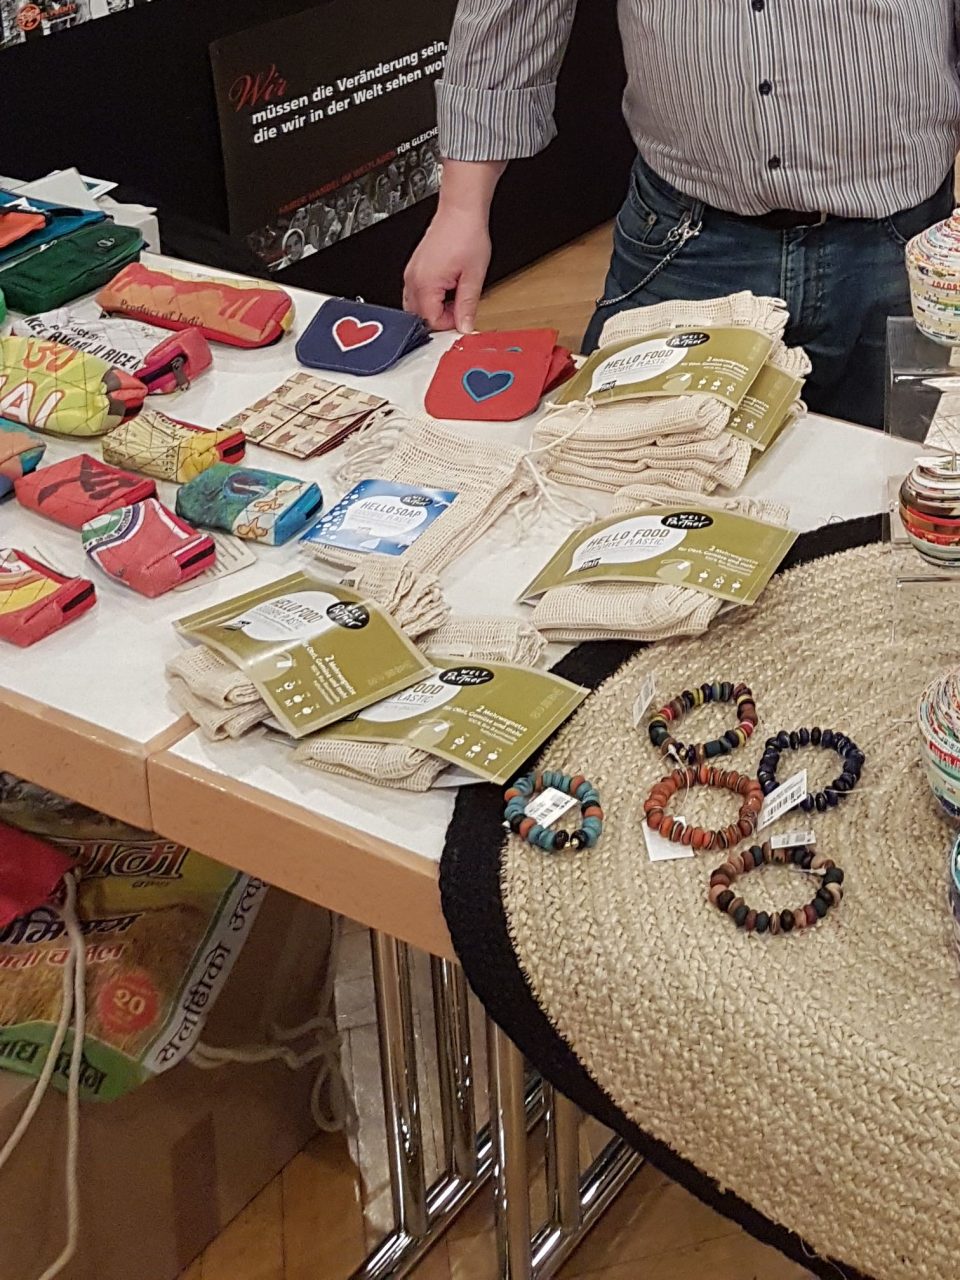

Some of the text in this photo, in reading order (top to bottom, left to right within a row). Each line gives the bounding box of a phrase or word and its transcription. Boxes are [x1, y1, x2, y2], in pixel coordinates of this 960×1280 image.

[228, 64, 288, 113] Wir
[252, 39, 448, 124] müssen die Veränderung sein,
[253, 127, 277, 144] die
[281, 116, 306, 133] wir
[310, 108, 324, 122] in
[327, 97, 351, 116] der
[352, 81, 383, 105] Welt
[385, 69, 422, 92] sehen
[396, 140, 411, 155] FÜR
[120, 299, 162, 321] Product
[101, 348, 136, 367] RICE
[604, 349, 674, 370] HELLO FOOD
[360, 501, 394, 514] HELLO
[393, 506, 422, 518] SOAP
[587, 528, 671, 548] HELLO FOOD
[273, 598, 324, 623] HELLO FOOD
